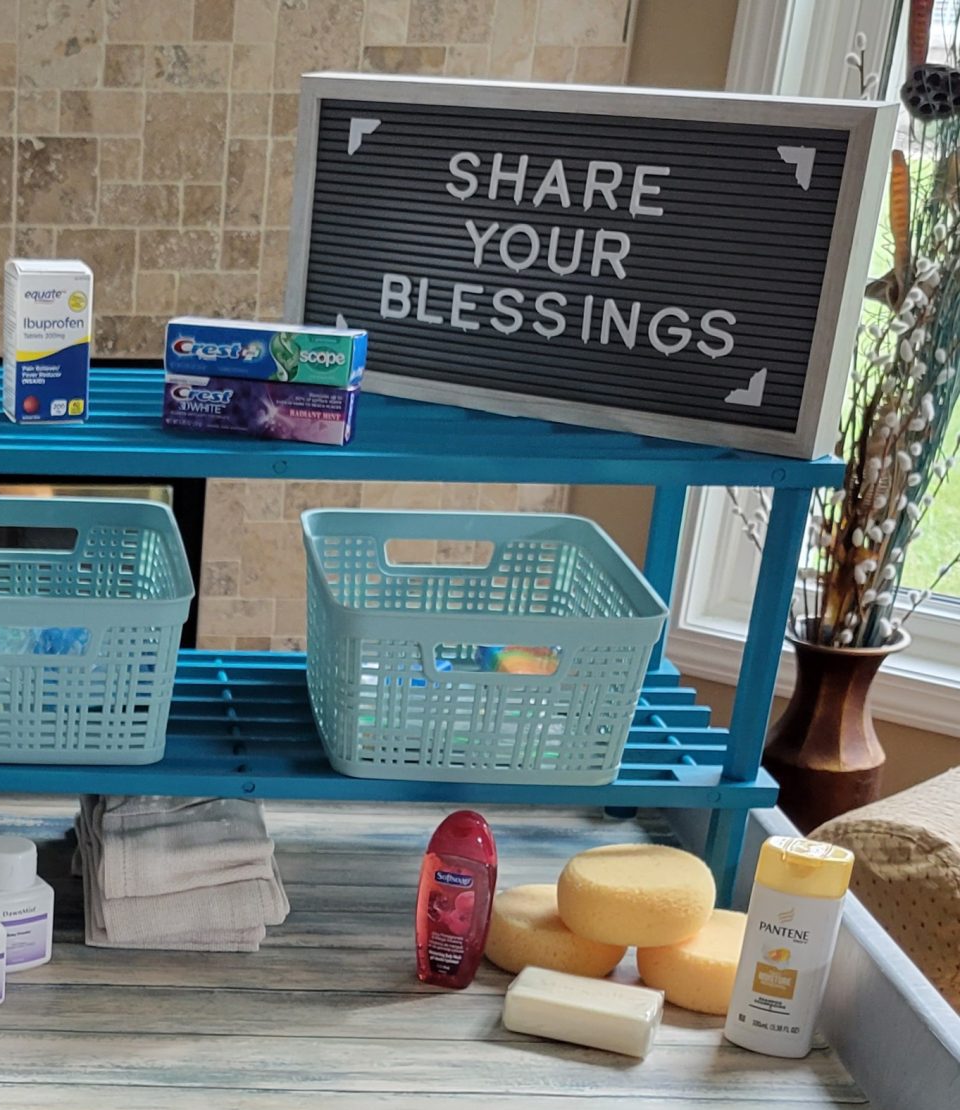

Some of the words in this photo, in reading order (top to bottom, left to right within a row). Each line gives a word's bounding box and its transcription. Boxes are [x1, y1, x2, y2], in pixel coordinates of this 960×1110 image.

[445, 151, 671, 219] SHARE
[465, 219, 632, 280] YOUR
[24, 289, 63, 301] equate
[23, 316, 85, 331] Ibuprofen
[380, 273, 738, 359] BLESSINGS
[171, 335, 242, 360] Crest
[299, 350, 345, 368] scope
[171, 384, 234, 404] Crest
[759, 920, 811, 941] PANTENE
